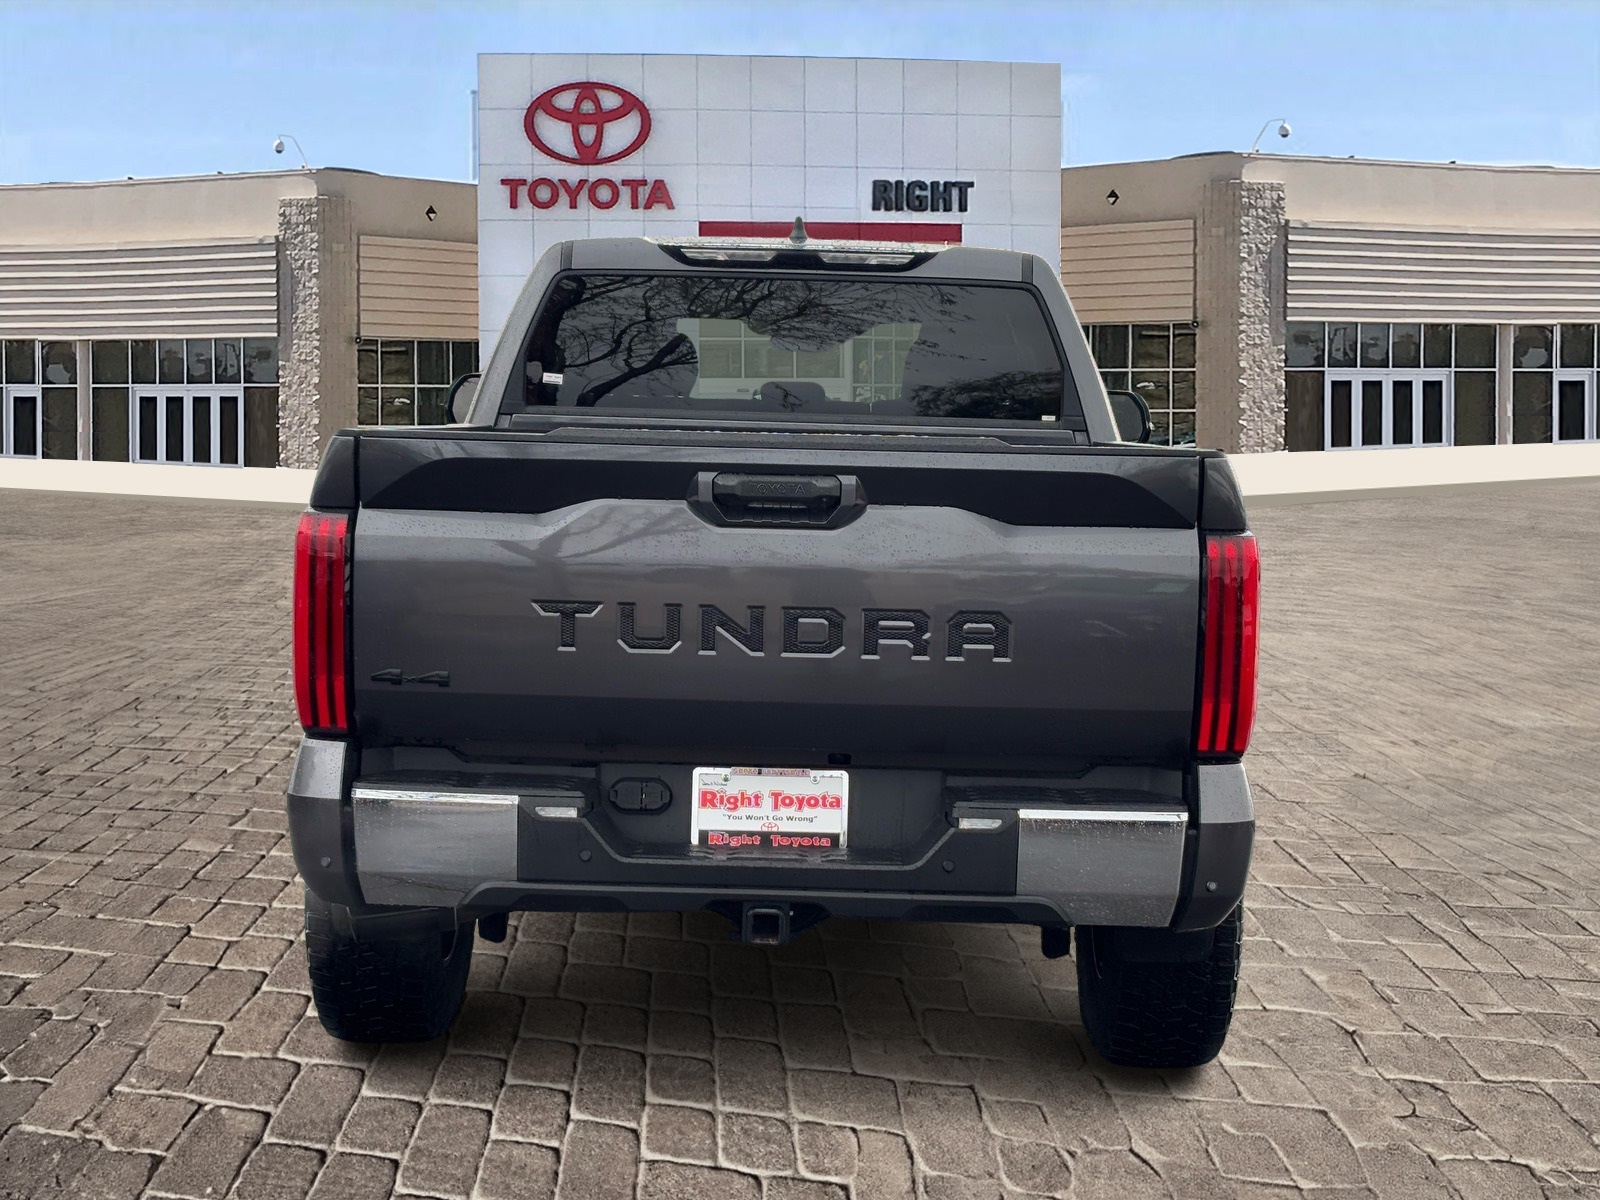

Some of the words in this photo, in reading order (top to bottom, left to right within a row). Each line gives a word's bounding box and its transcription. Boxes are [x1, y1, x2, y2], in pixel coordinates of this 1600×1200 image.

[500, 177, 676, 210] TOYOTA
[871, 179, 975, 213] RIGHT
[531, 599, 1013, 663] TUNDRA
[699, 788, 764, 812] Right
[768, 789, 842, 812] Toyota
[708, 832, 761, 847] Right
[771, 834, 831, 847] Toyota
